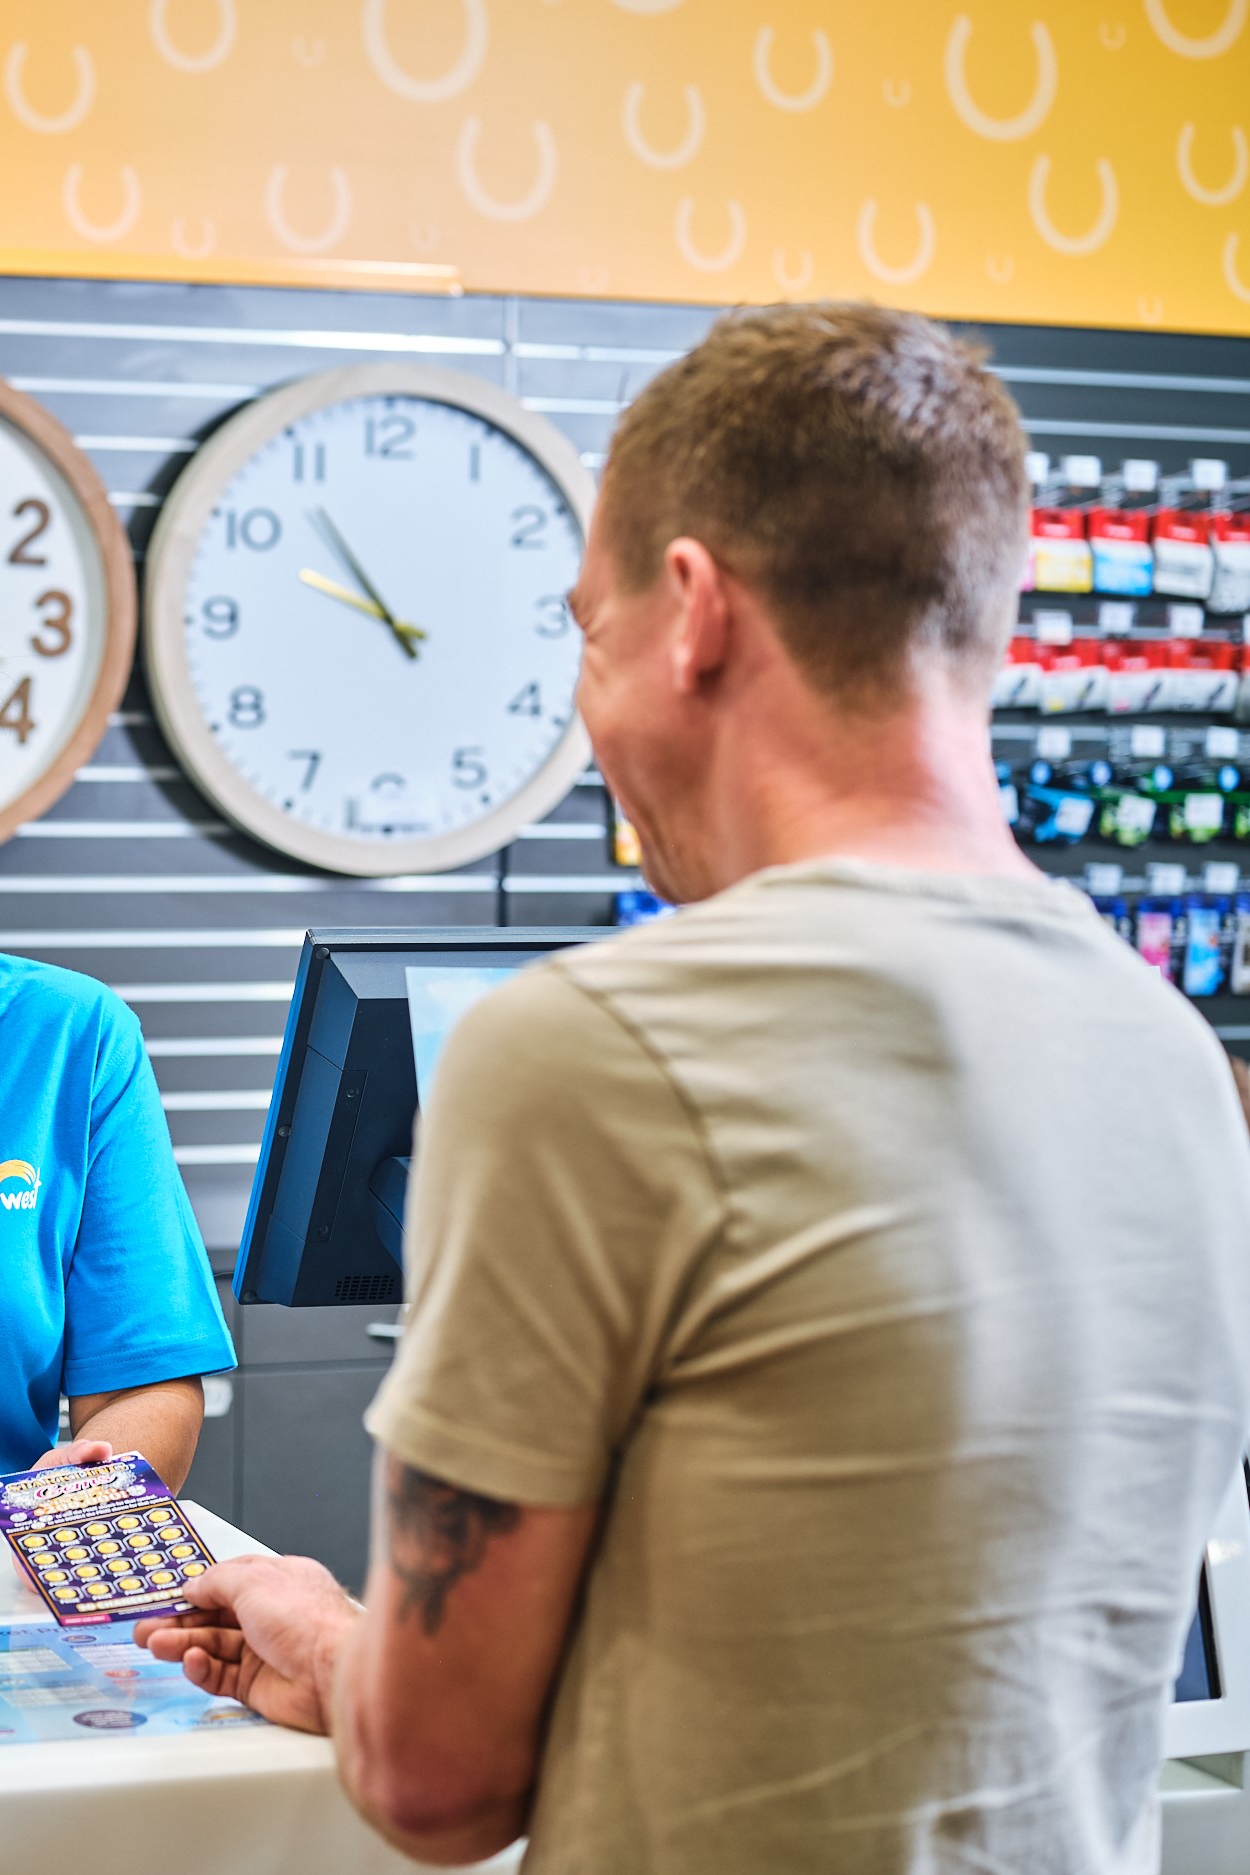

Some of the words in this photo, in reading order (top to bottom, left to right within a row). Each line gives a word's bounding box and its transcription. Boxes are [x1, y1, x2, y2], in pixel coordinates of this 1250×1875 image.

[364, 416, 417, 460] 12
[293, 443, 325, 483] 11
[470, 443, 480, 483] 1
[8, 498, 52, 566] 2
[227, 507, 283, 552] 10
[510, 505, 547, 549] 2
[31, 588, 73, 658] 3
[201, 595, 240, 641] 9
[535, 595, 569, 640] 3
[227, 685, 266, 730] 8
[507, 682, 543, 720] 4
[288, 749, 322, 793] 7
[453, 747, 488, 790] 5
[7, 1462, 128, 1493] SPARKLING
